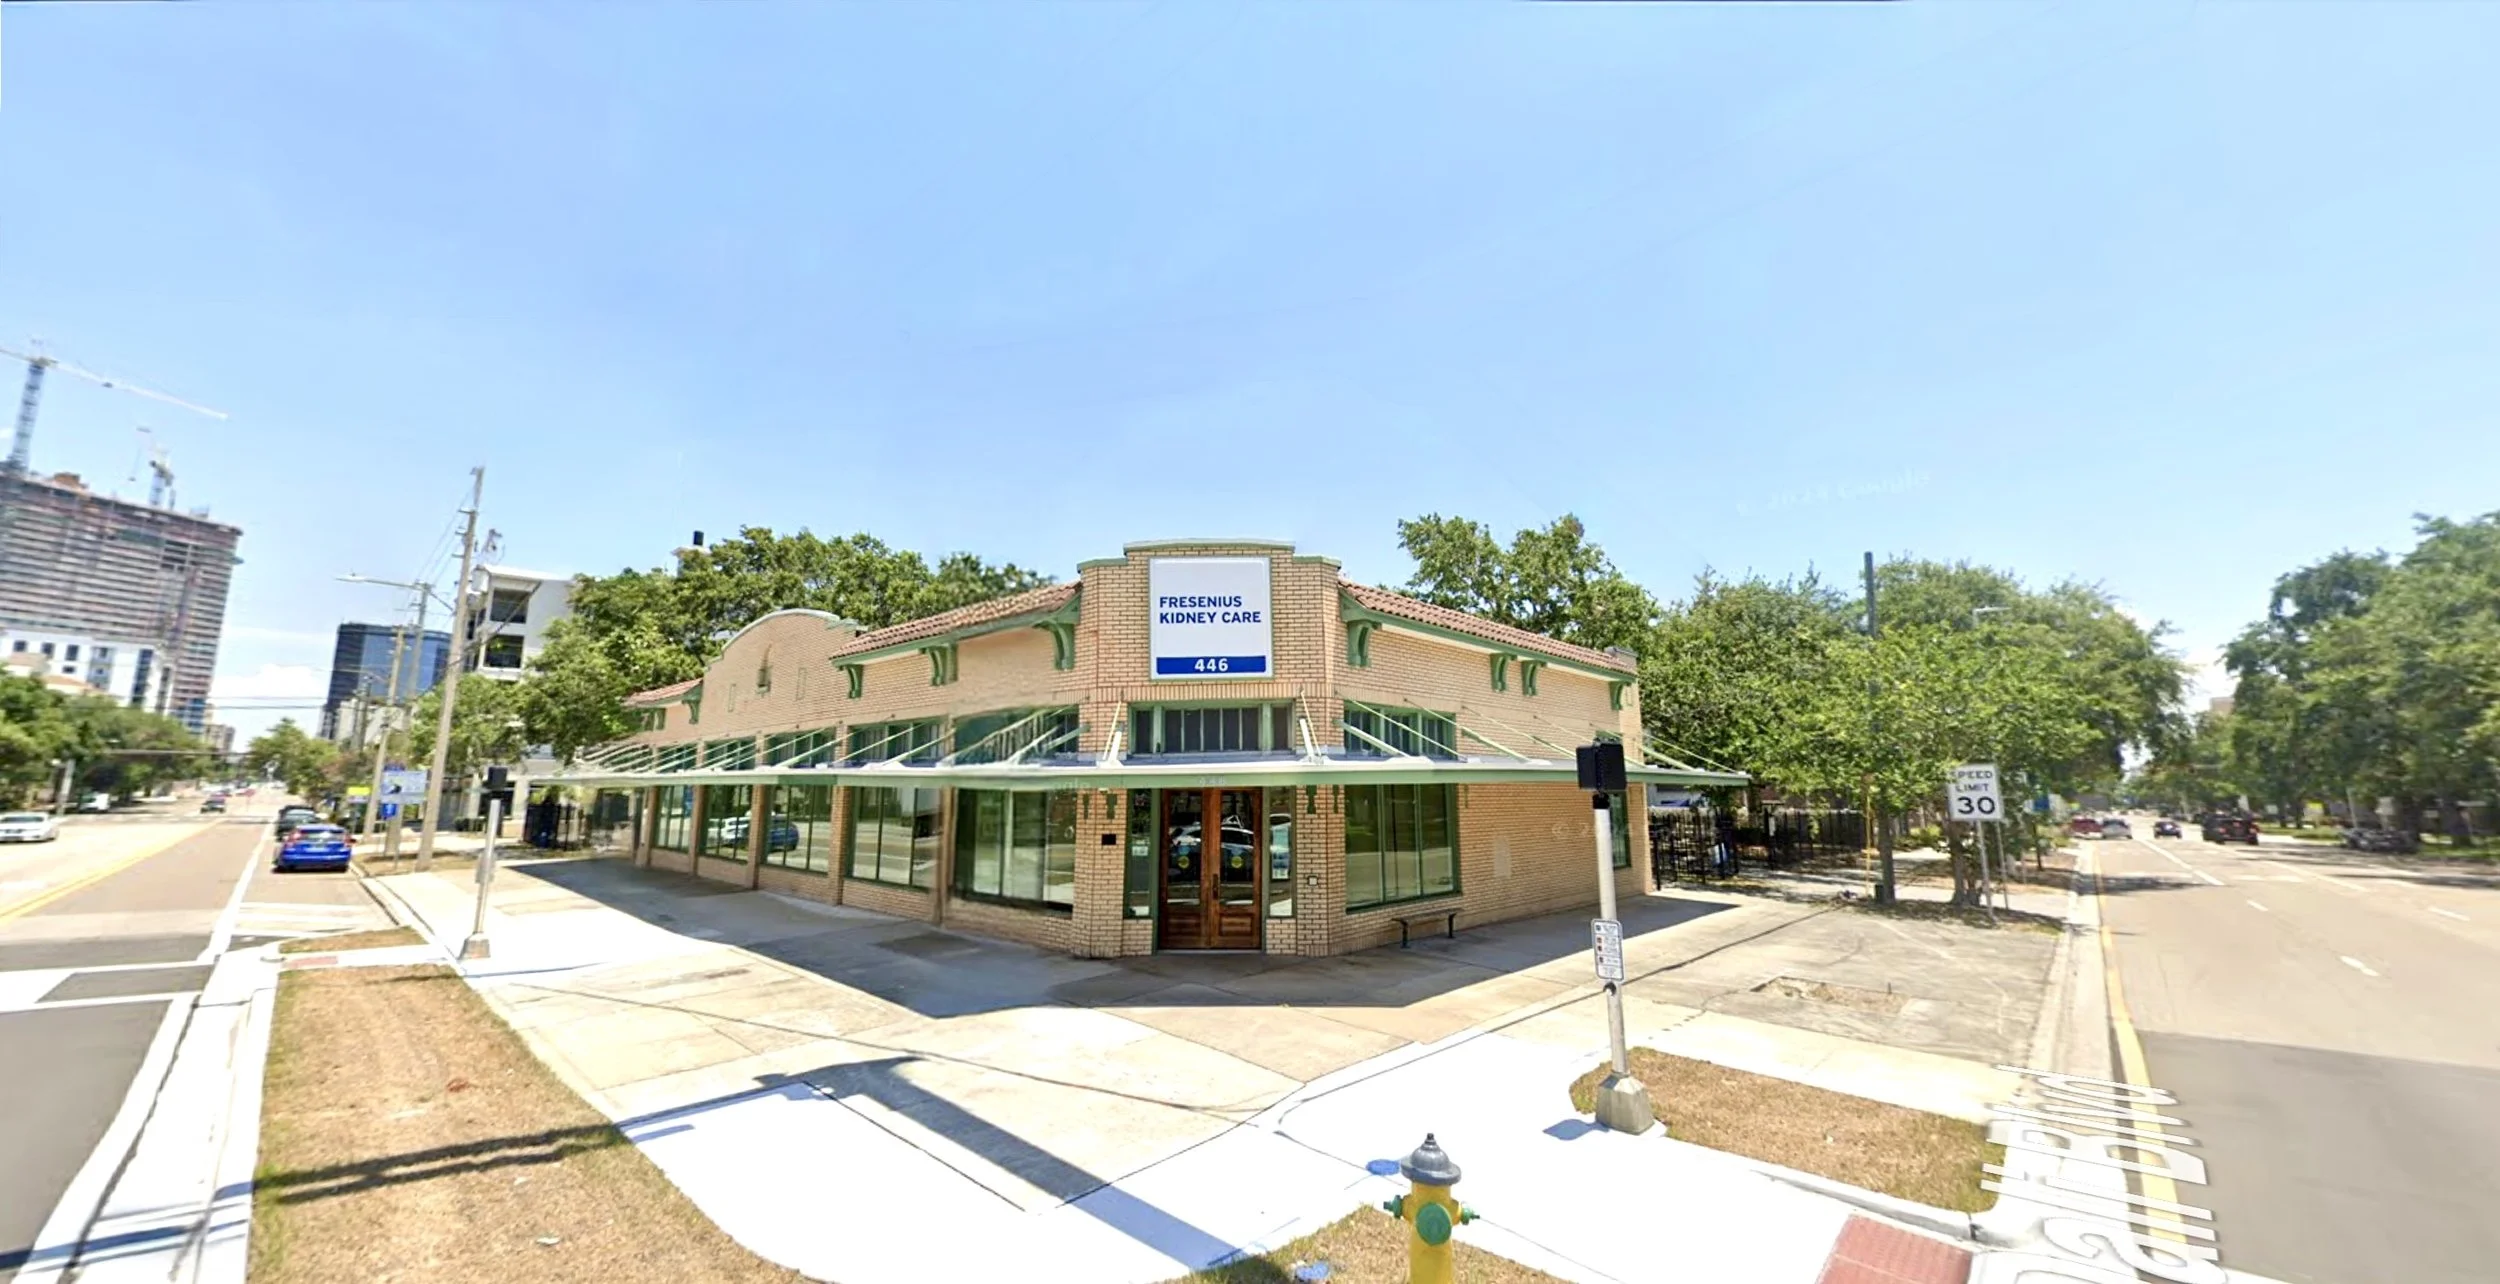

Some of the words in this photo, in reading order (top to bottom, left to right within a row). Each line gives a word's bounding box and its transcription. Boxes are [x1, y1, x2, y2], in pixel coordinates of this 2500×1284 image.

[1159, 595, 1242, 609] FRESENIUS
[1159, 611, 1217, 624] KIDNEY
[1221, 611, 1261, 623] CARE
[1194, 658, 1229, 672] 446
[1955, 783, 1989, 792] LIMIT
[1957, 796, 1995, 815] 30
